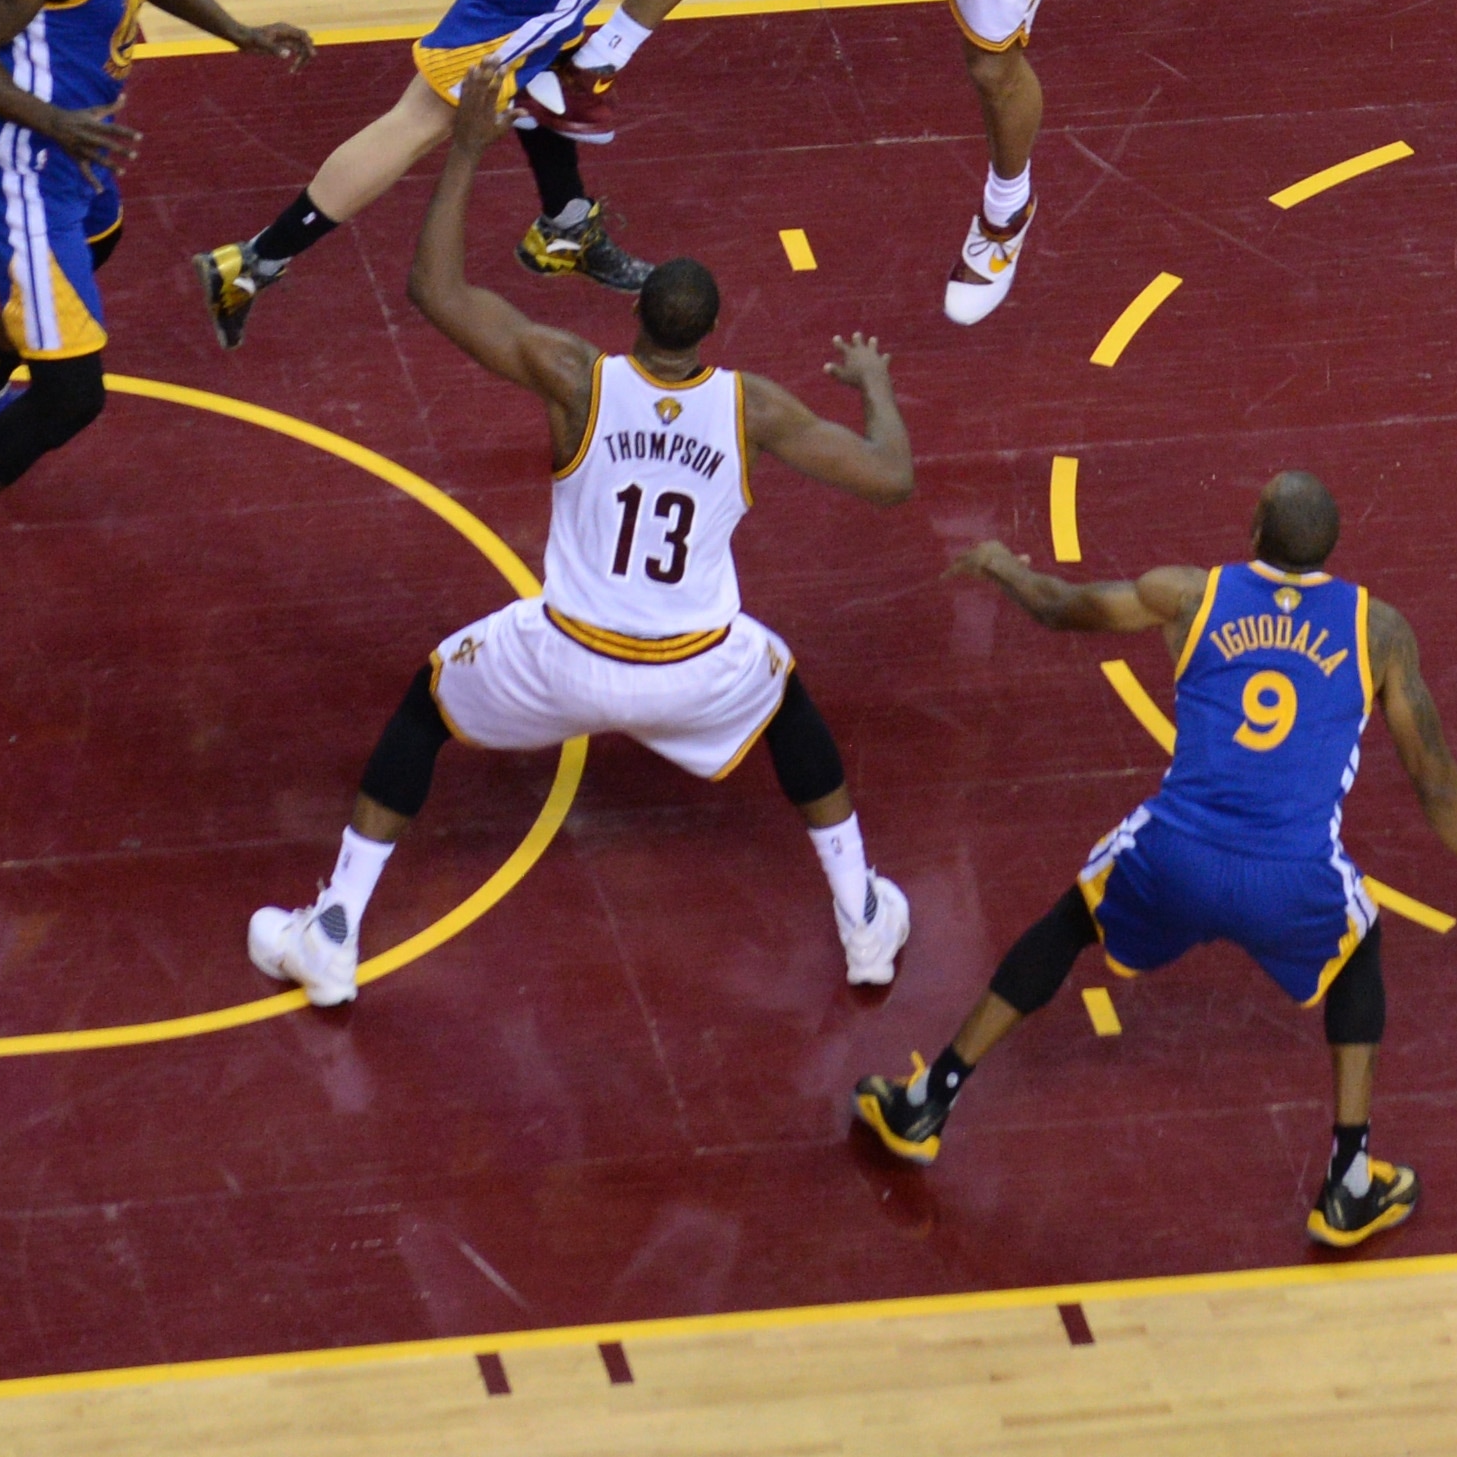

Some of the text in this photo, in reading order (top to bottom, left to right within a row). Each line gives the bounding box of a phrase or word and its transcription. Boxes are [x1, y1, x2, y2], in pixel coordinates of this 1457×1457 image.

[604, 431, 725, 481] THOMPSON
[611, 483, 696, 584] 13
[1209, 614, 1349, 677] IGUODALA
[1233, 670, 1298, 752] 9
